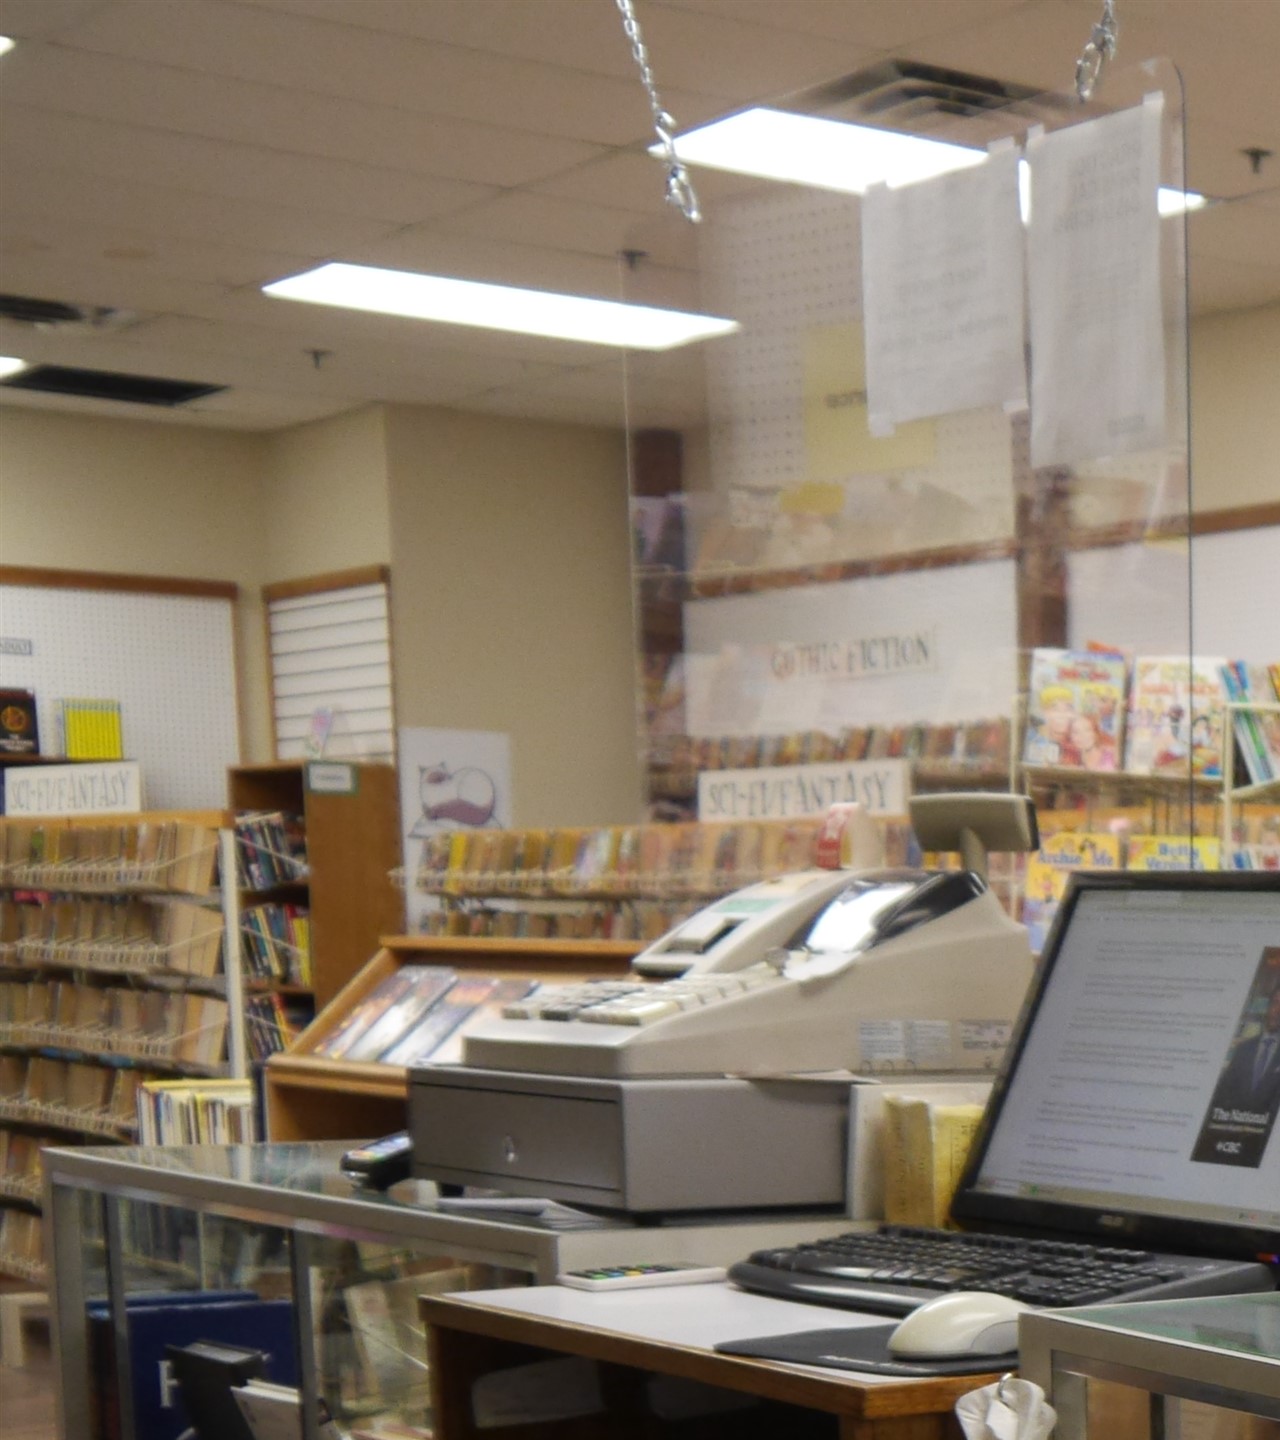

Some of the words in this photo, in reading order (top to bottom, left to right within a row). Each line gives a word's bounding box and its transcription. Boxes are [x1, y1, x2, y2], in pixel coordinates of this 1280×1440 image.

[846, 632, 931, 675] FICTION
[1211, 1107, 1230, 1122] The
[1231, 1108, 1270, 1125] National
